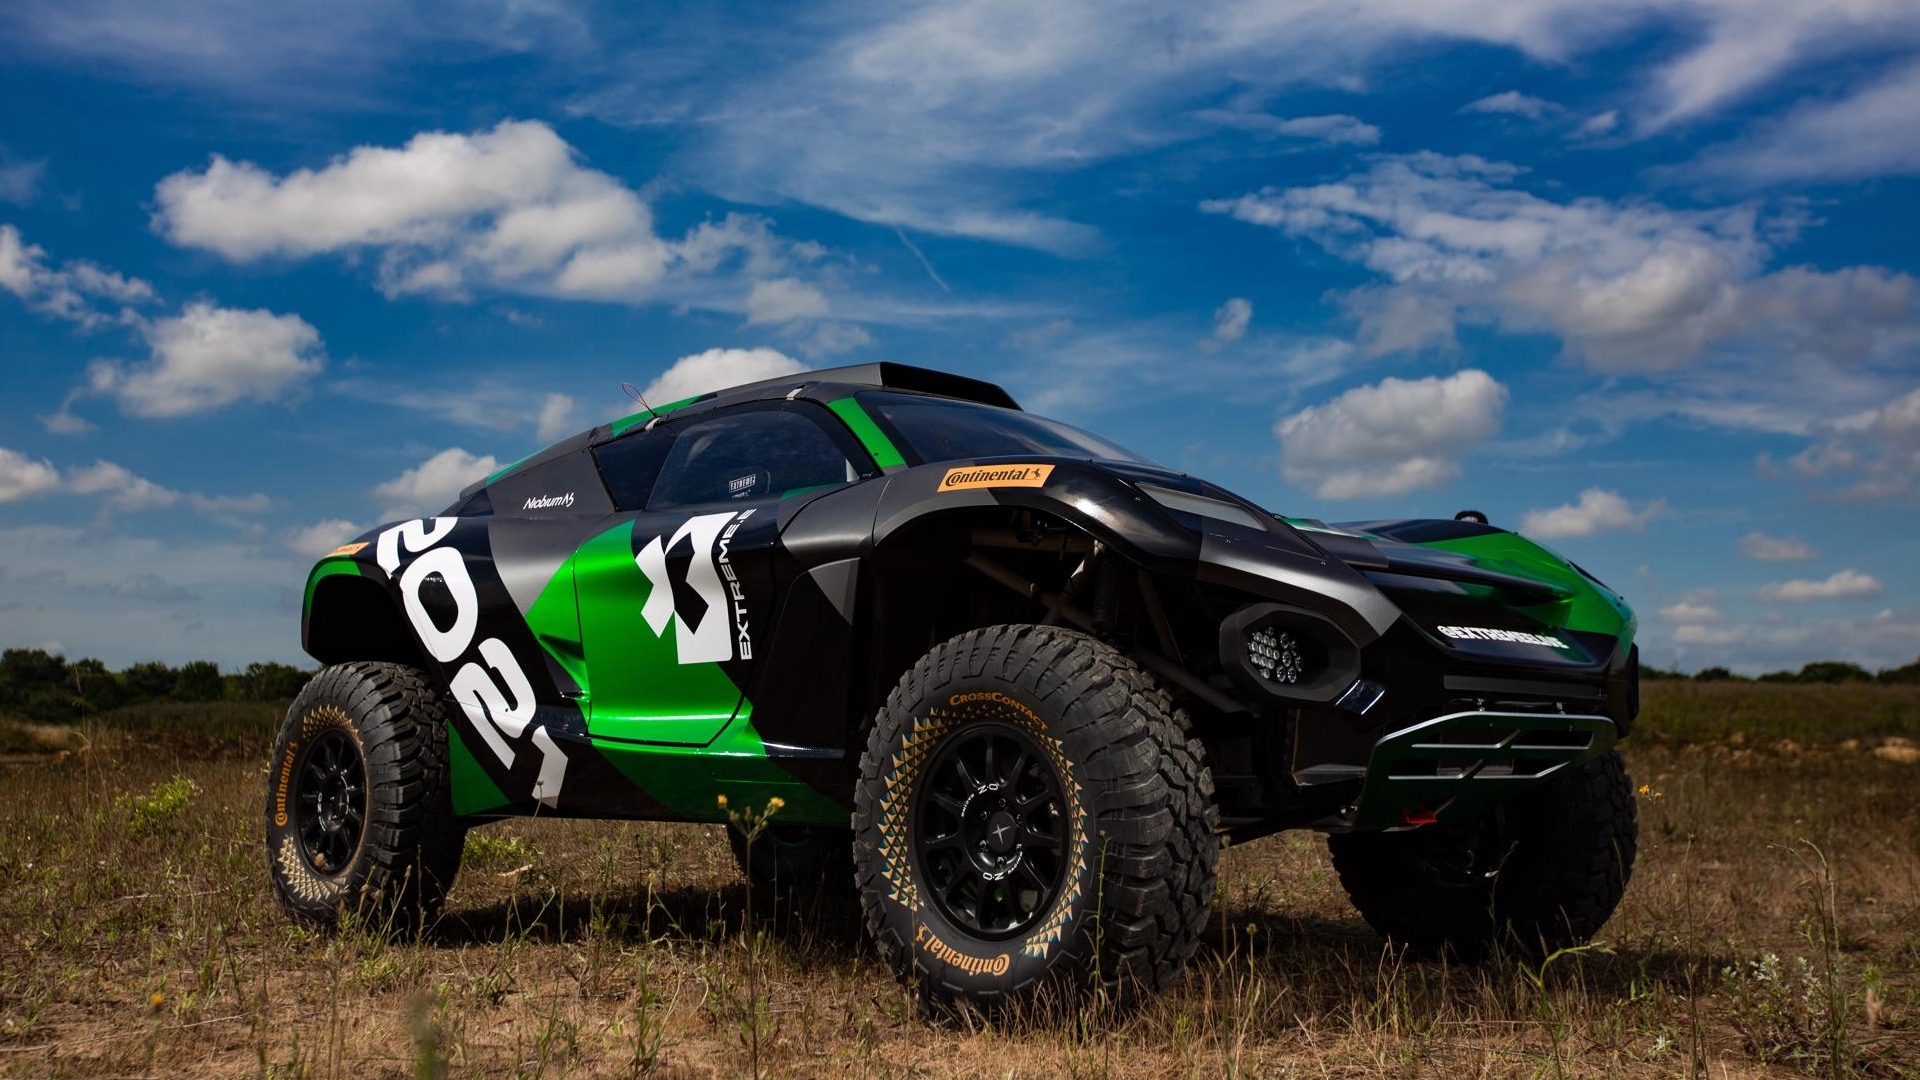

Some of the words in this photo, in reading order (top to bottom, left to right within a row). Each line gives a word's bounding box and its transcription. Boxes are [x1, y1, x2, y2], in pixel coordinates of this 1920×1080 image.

[945, 468, 1030, 487] Continental
[275, 747, 296, 827] Continental
[923, 934, 1010, 976] Continental
